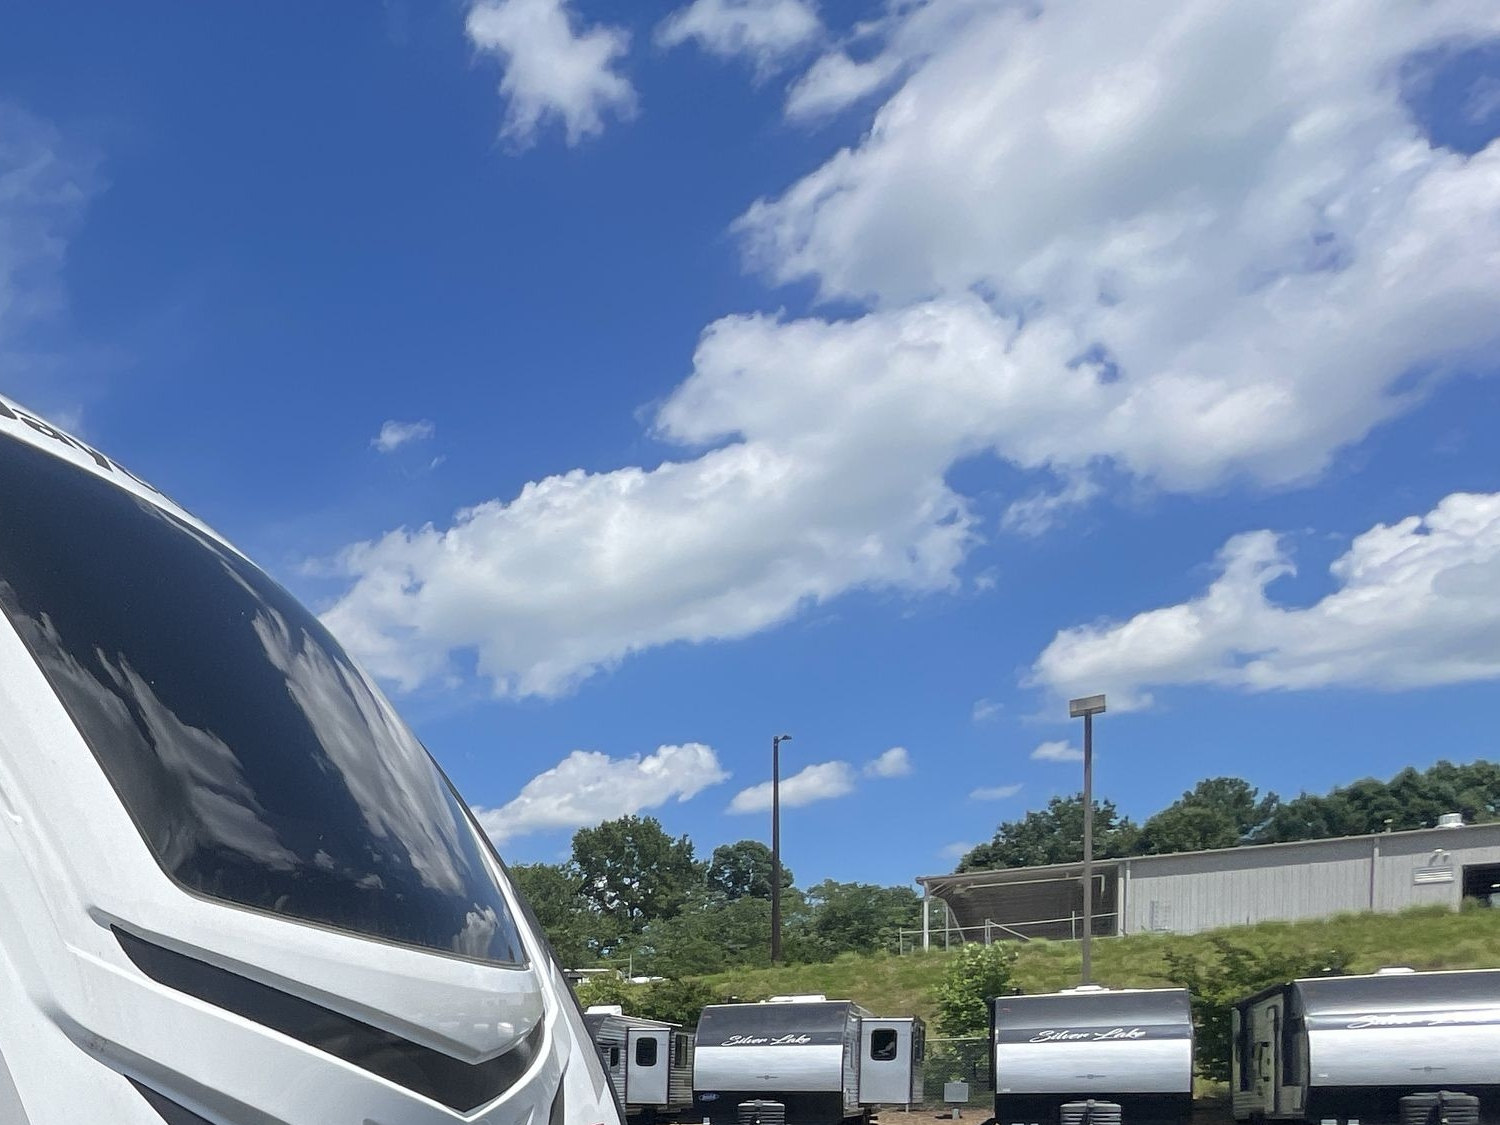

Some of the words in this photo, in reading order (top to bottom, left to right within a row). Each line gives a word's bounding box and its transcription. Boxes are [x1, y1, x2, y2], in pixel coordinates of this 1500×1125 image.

[720, 1034, 768, 1047] Silver
[769, 1033, 812, 1046] Lake
[1028, 1029, 1090, 1043] Silver
[1092, 1028, 1146, 1041] Lake
